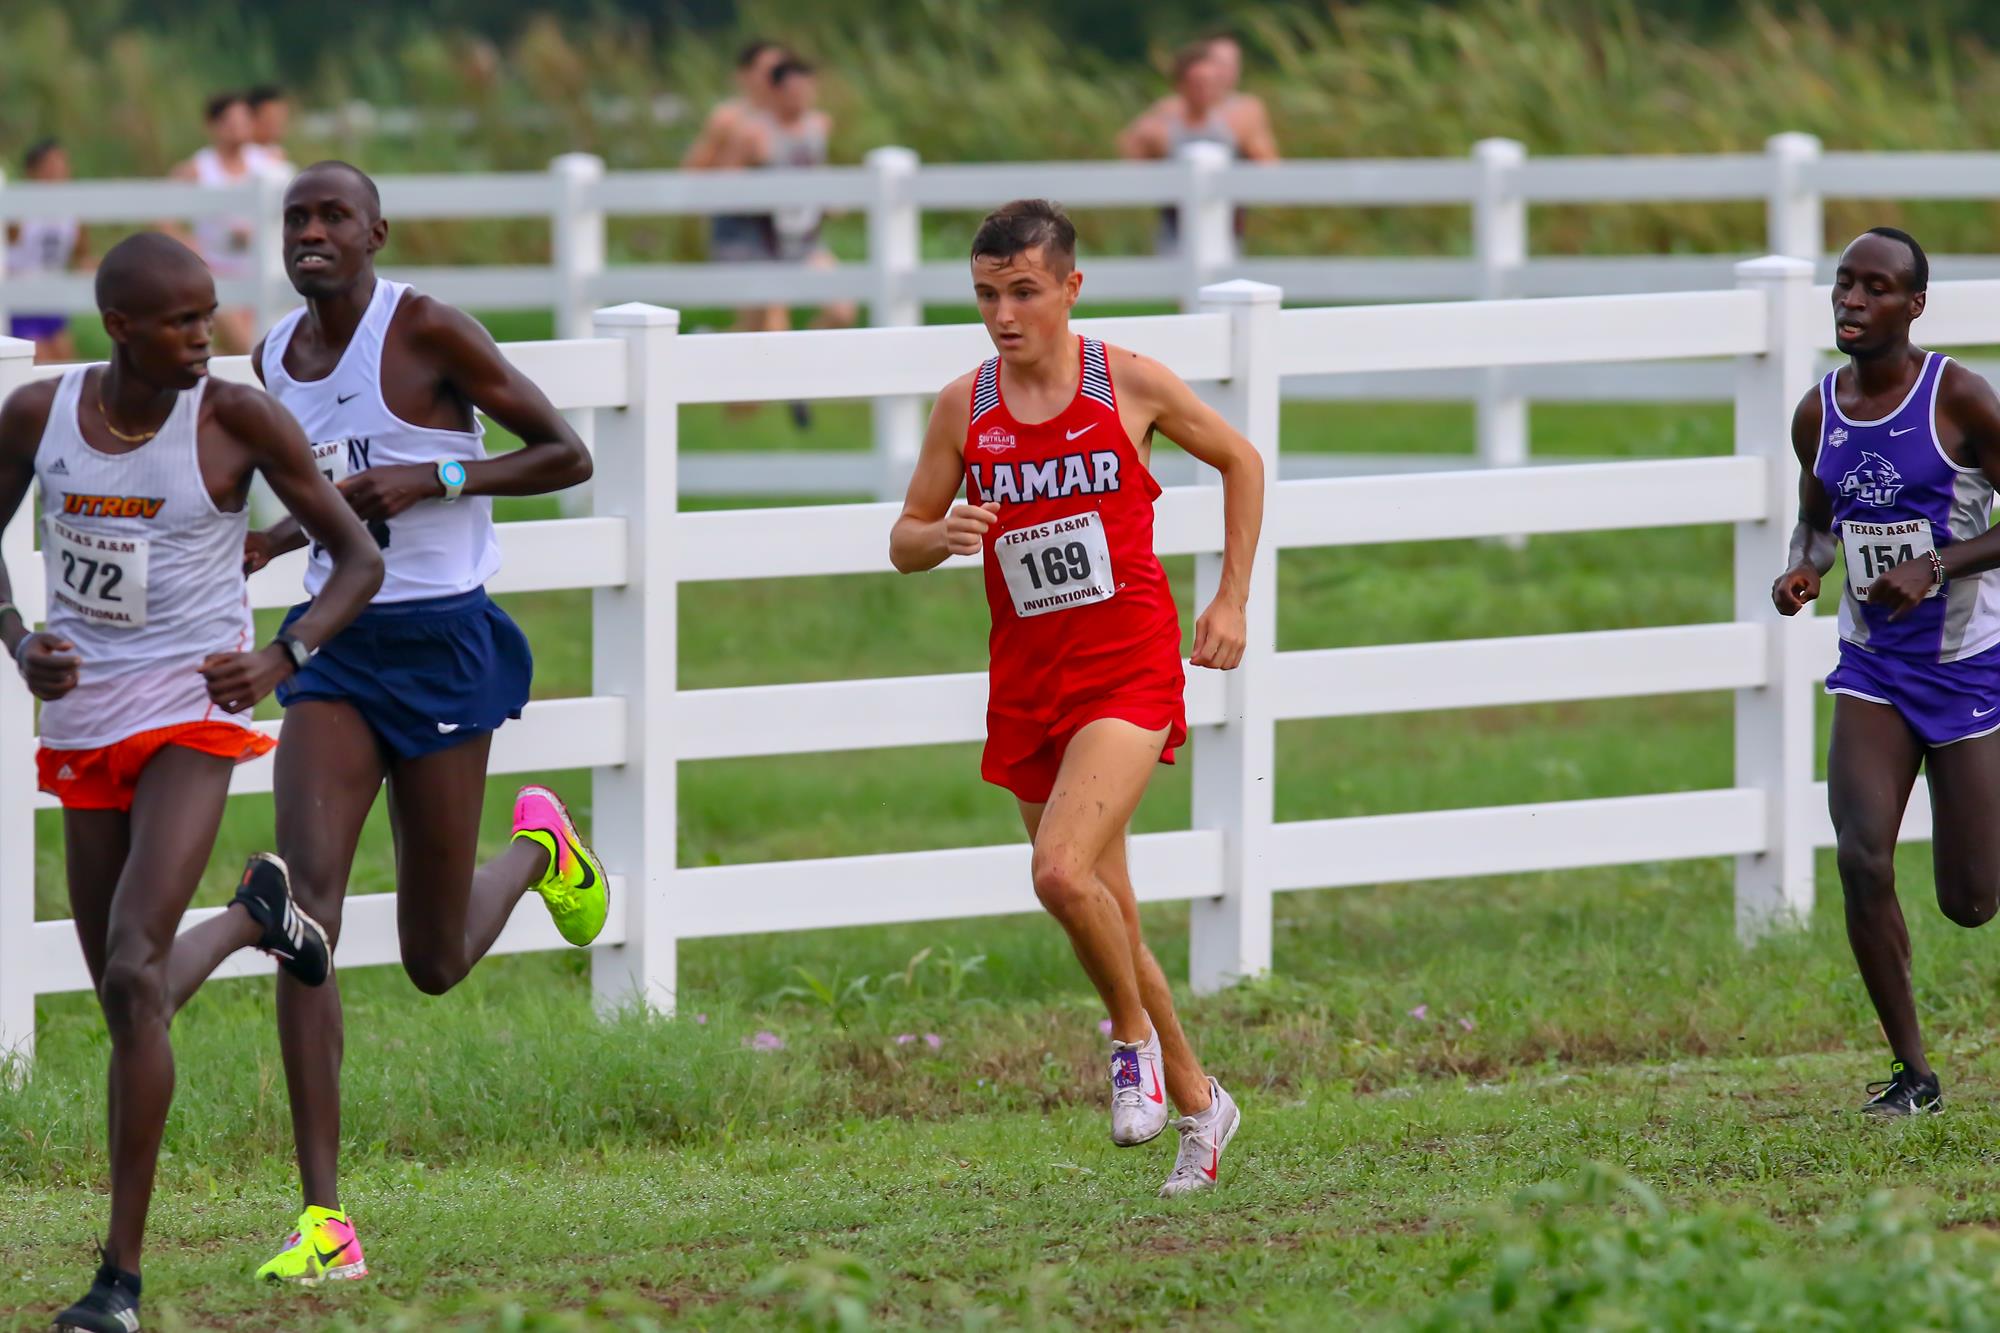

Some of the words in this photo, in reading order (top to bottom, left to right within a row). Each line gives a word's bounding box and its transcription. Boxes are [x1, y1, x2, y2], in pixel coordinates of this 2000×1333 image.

[970, 450, 1120, 503] LAMAR
[1841, 473, 1897, 505] ACU
[61, 491, 166, 519] UTRGV
[1003, 526, 1050, 545] TEXAS
[1054, 516, 1090, 534] A&M
[1849, 524, 1883, 536] TEXAS
[1886, 522, 1920, 536] A&M
[96, 540, 135, 553] A&M
[61, 549, 123, 602] 272
[1020, 541, 1092, 590] 169
[54, 590, 133, 622] ATIONAL
[1023, 585, 1105, 611] INVITATIONAL
